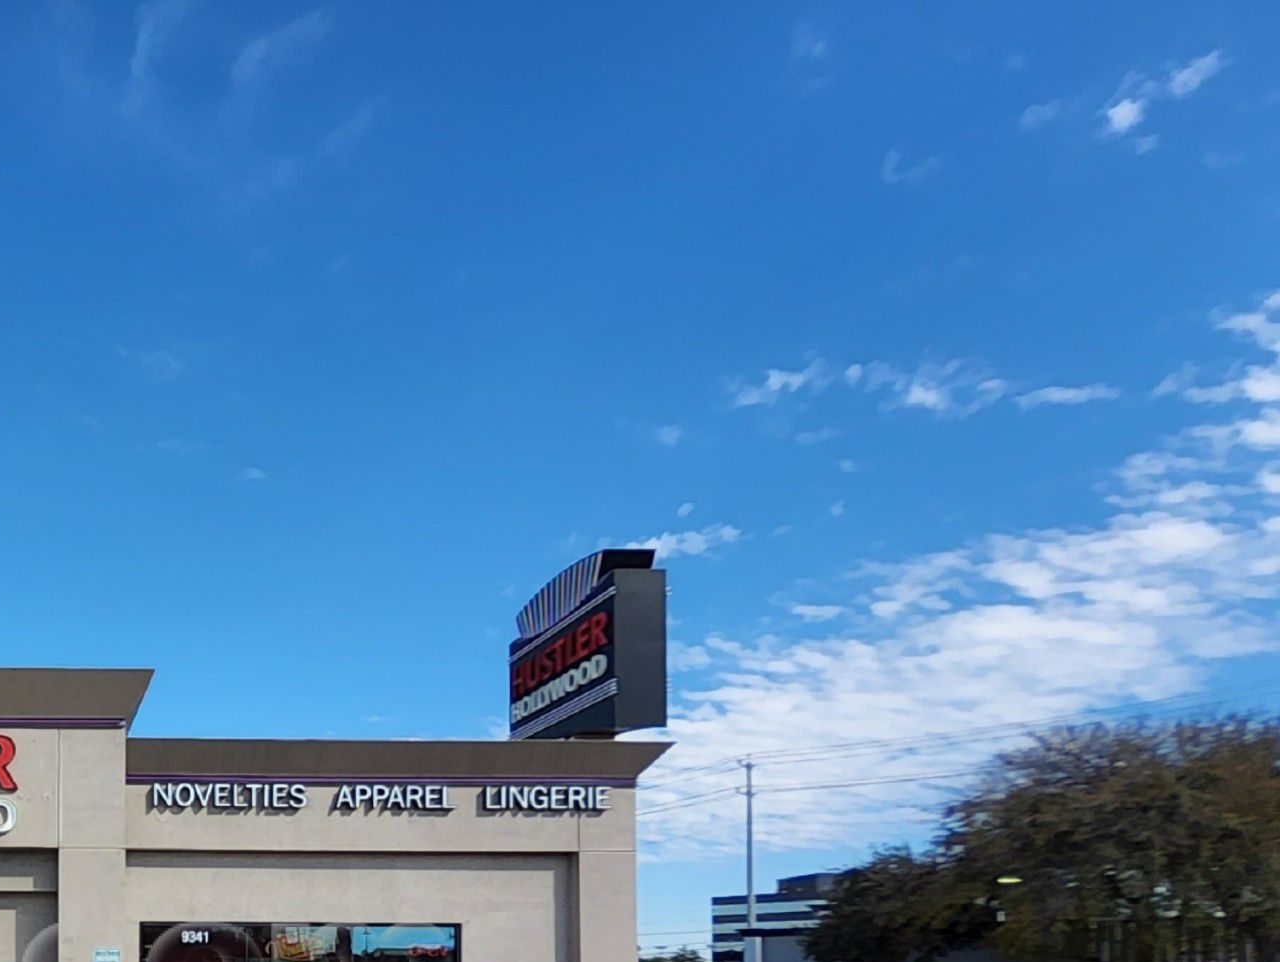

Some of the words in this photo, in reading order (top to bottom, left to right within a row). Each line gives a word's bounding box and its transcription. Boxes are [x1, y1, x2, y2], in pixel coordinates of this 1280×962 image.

[511, 611, 609, 701] HUSTLER
[152, 782, 308, 808] NOVELTIES
[336, 784, 458, 809] APPAREL
[485, 785, 613, 810] LINGERIE
[181, 930, 209, 943] 9341
